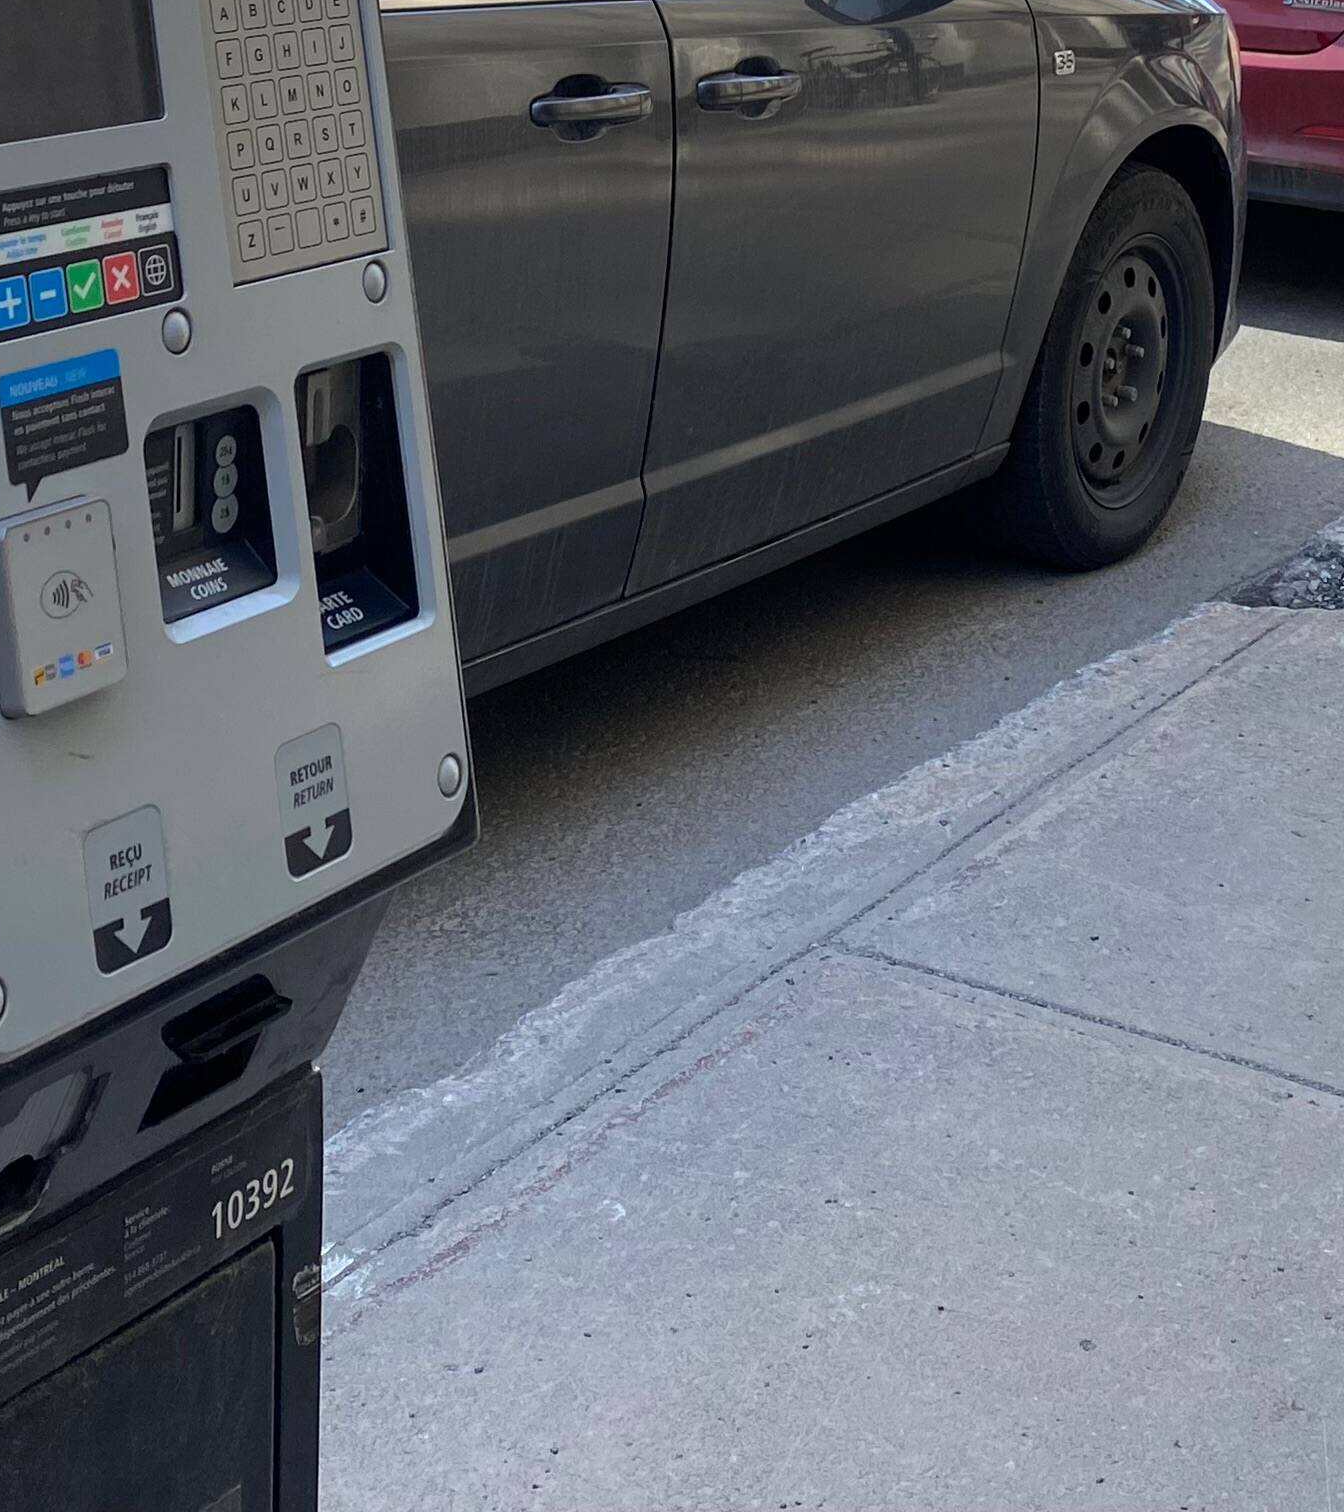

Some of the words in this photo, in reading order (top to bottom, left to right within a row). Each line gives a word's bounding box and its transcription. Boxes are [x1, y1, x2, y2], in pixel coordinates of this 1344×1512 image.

[220, 8, 229, 20] A
[249, 4, 257, 16] B
[278, 0, 285, 13] C
[226, 52, 232, 65] F
[255, 48, 263, 61] G
[283, 45, 291, 57] H
[339, 37, 344, 49] J
[1057, 54, 1074, 70] 35
[231, 98, 239, 110] K
[261, 94, 267, 106] L
[288, 88, 297, 101] M
[316, 85, 324, 96] N
[343, 80, 351, 92] O
[237, 143, 244, 156] P
[265, 137, 274, 150] Q
[294, 133, 302, 145] R
[322, 128, 329, 141] S
[349, 123, 355, 136] T
[242, 189, 250, 202] U
[271, 183, 278, 196] V
[298, 177, 308, 190] W
[328, 172, 335, 184] X
[354, 166, 360, 178] Y
[248, 234, 256, 248] Z
[9, 375, 58, 397] NOUVEAU
[166, 557, 229, 588] MONNAIE
[190, 577, 228, 601] COINS
[319, 590, 354, 613] ARTE
[326, 606, 364, 630] CARD
[289, 755, 333, 786] RETOUR
[293, 777, 334, 809] RETURN
[109, 842, 143, 870] REÇU
[103, 864, 152, 900] RECEIPT
[211, 1157, 295, 1240] 10392
[18, 1256, 65, 1291] MONTRÉAL
